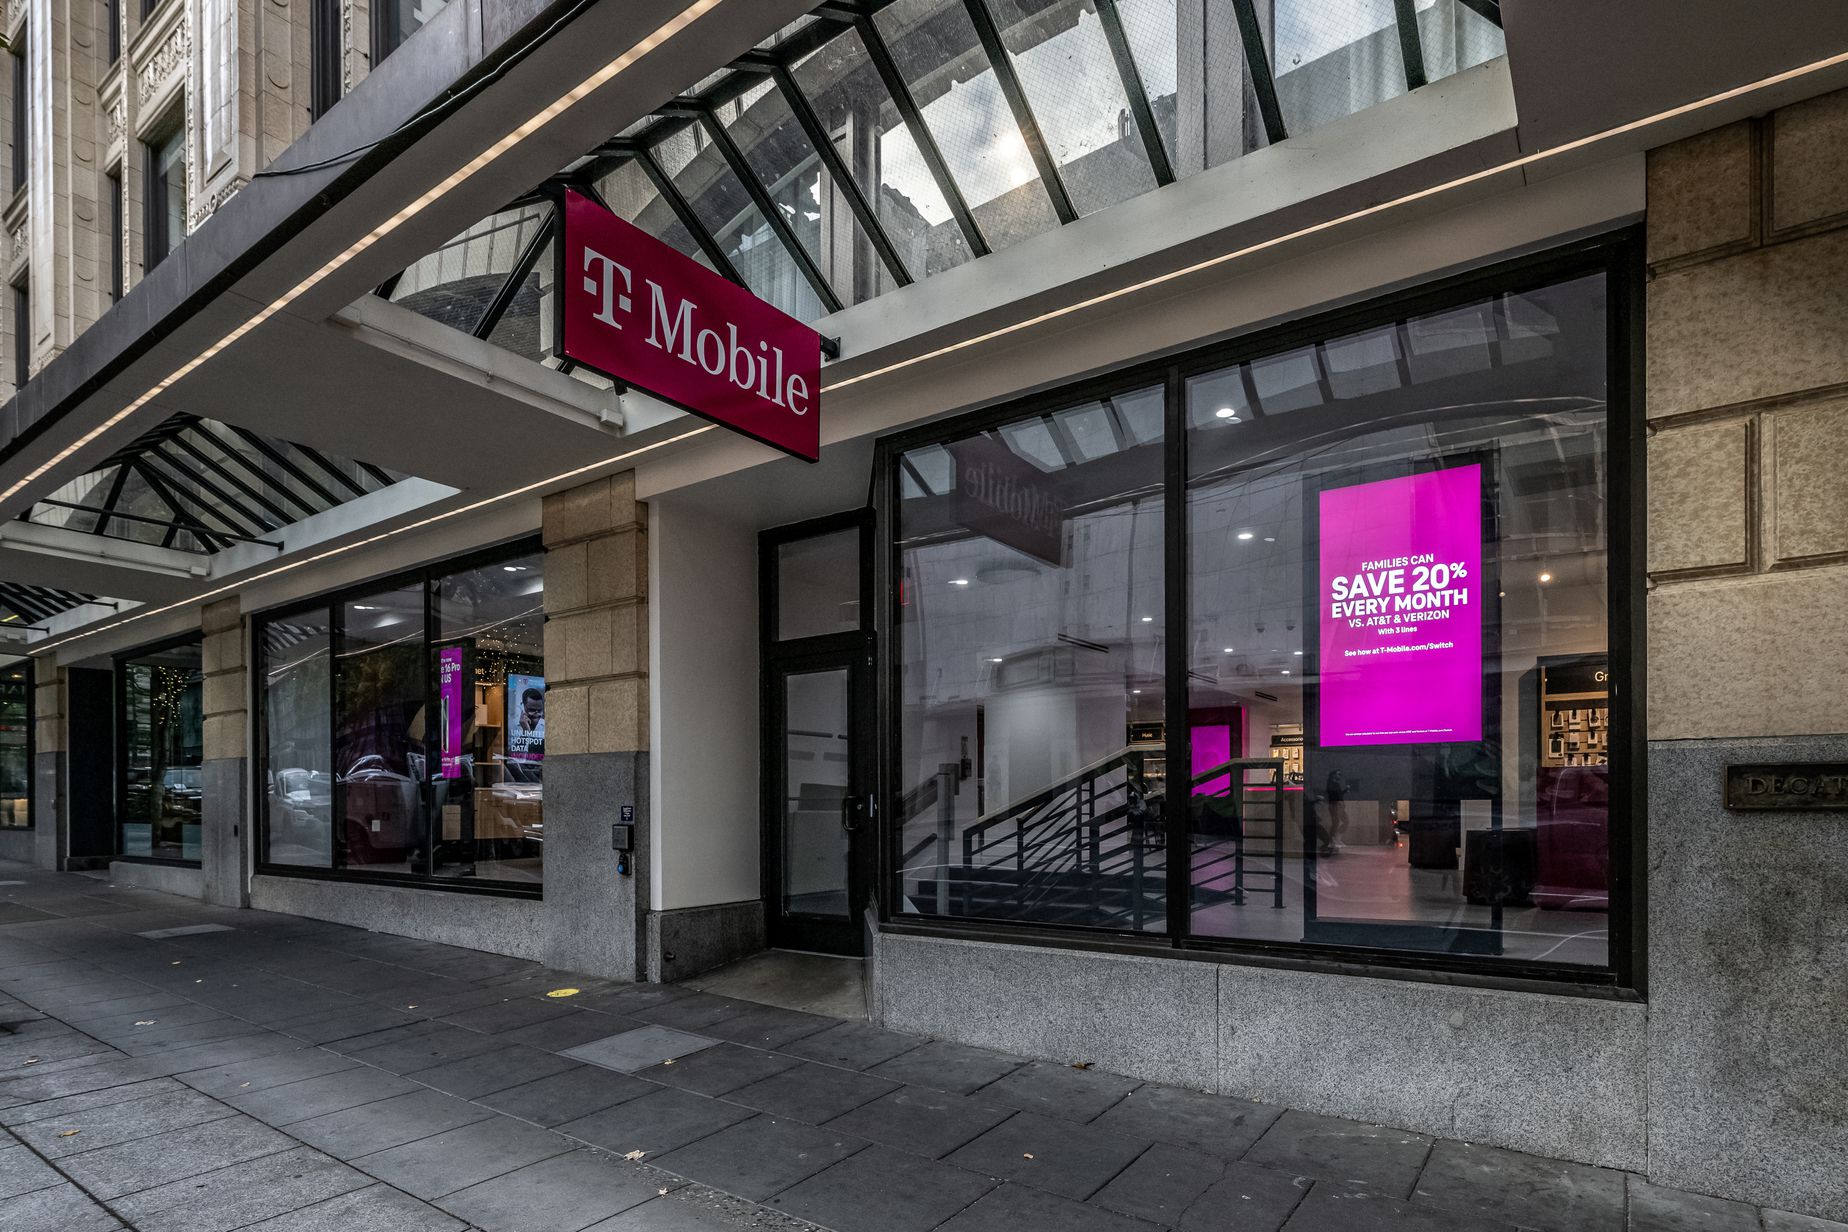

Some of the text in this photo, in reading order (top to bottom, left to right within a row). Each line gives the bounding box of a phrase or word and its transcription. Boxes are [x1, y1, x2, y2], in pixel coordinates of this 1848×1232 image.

[645, 278, 809, 416] Mobile
[1362, 553, 1434, 571] FAMILIES CAN
[1331, 562, 1468, 601] SAVE 20%
[1331, 588, 1468, 618] EVERY MONTH
[1348, 609, 1450, 628] VS. AT&T & VERIZON
[1378, 627, 1394, 635] With
[1401, 626, 1418, 634] lines
[1344, 649, 1357, 657] See
[1380, 641, 1454, 653] T-Mobile.com/Switch
[451, 662, 461, 671] Pro
[1594, 671, 1609, 682] Gr
[511, 737, 543, 746] HOTSPOT
[511, 745, 528, 753] DATA
